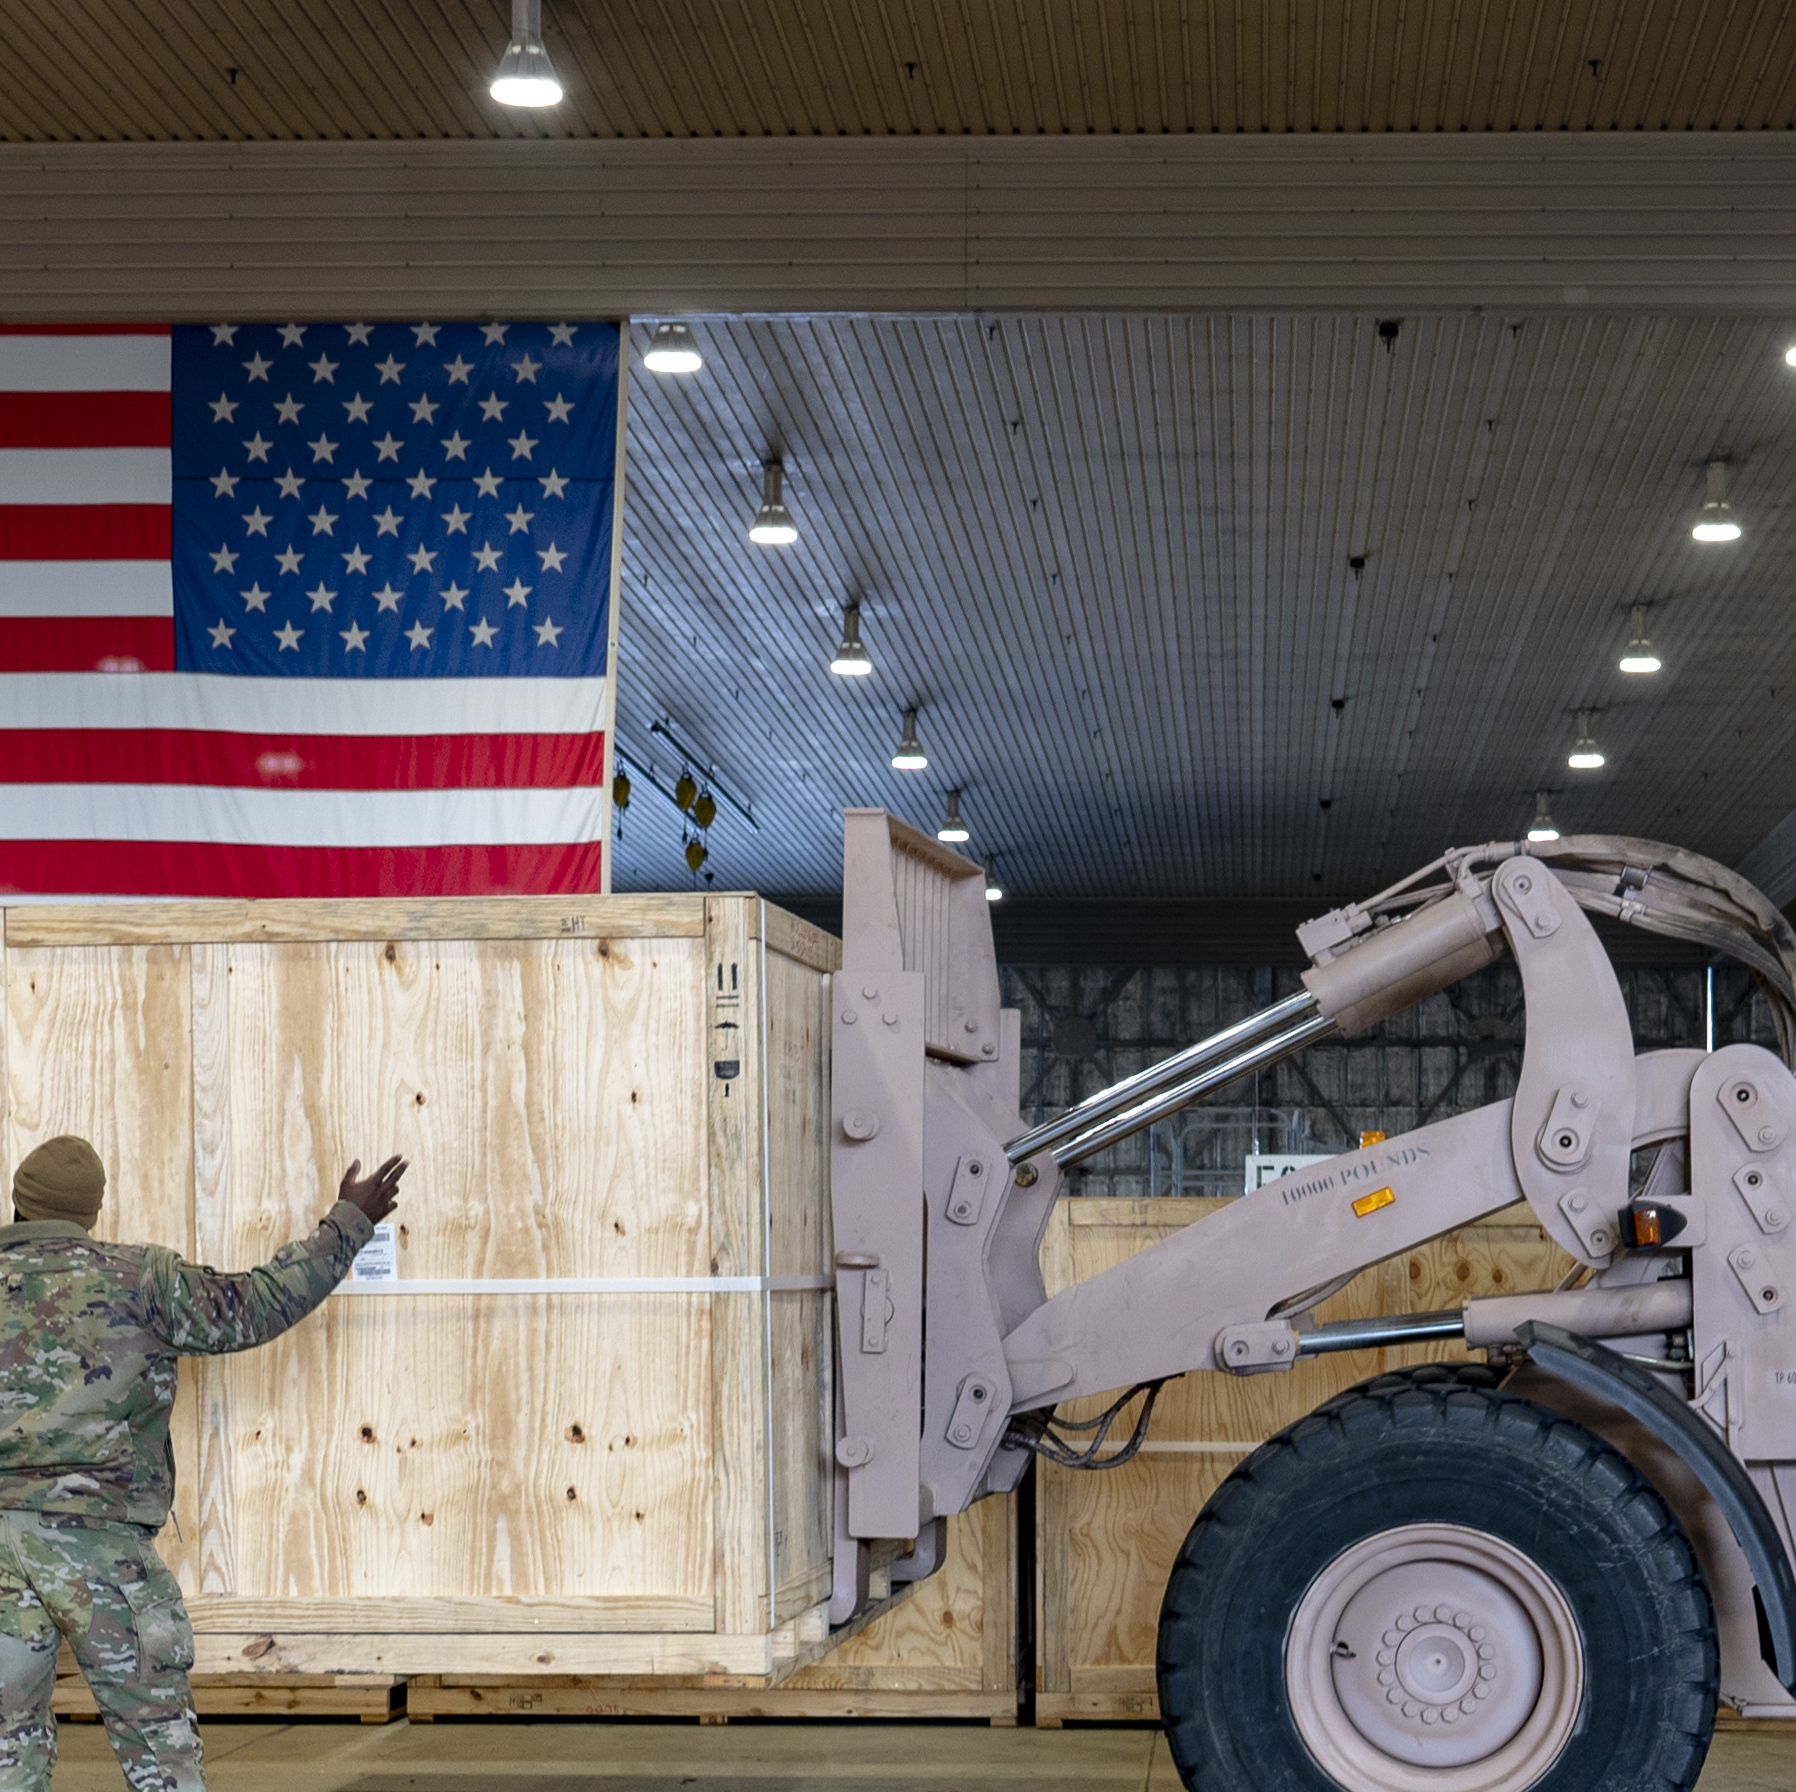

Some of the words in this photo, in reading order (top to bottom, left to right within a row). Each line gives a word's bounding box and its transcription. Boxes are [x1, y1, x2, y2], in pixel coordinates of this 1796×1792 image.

[1282, 1176, 1335, 1206] 10000
[1775, 1371, 1784, 1384] TP
[1787, 1371, 1796, 1385] 60
